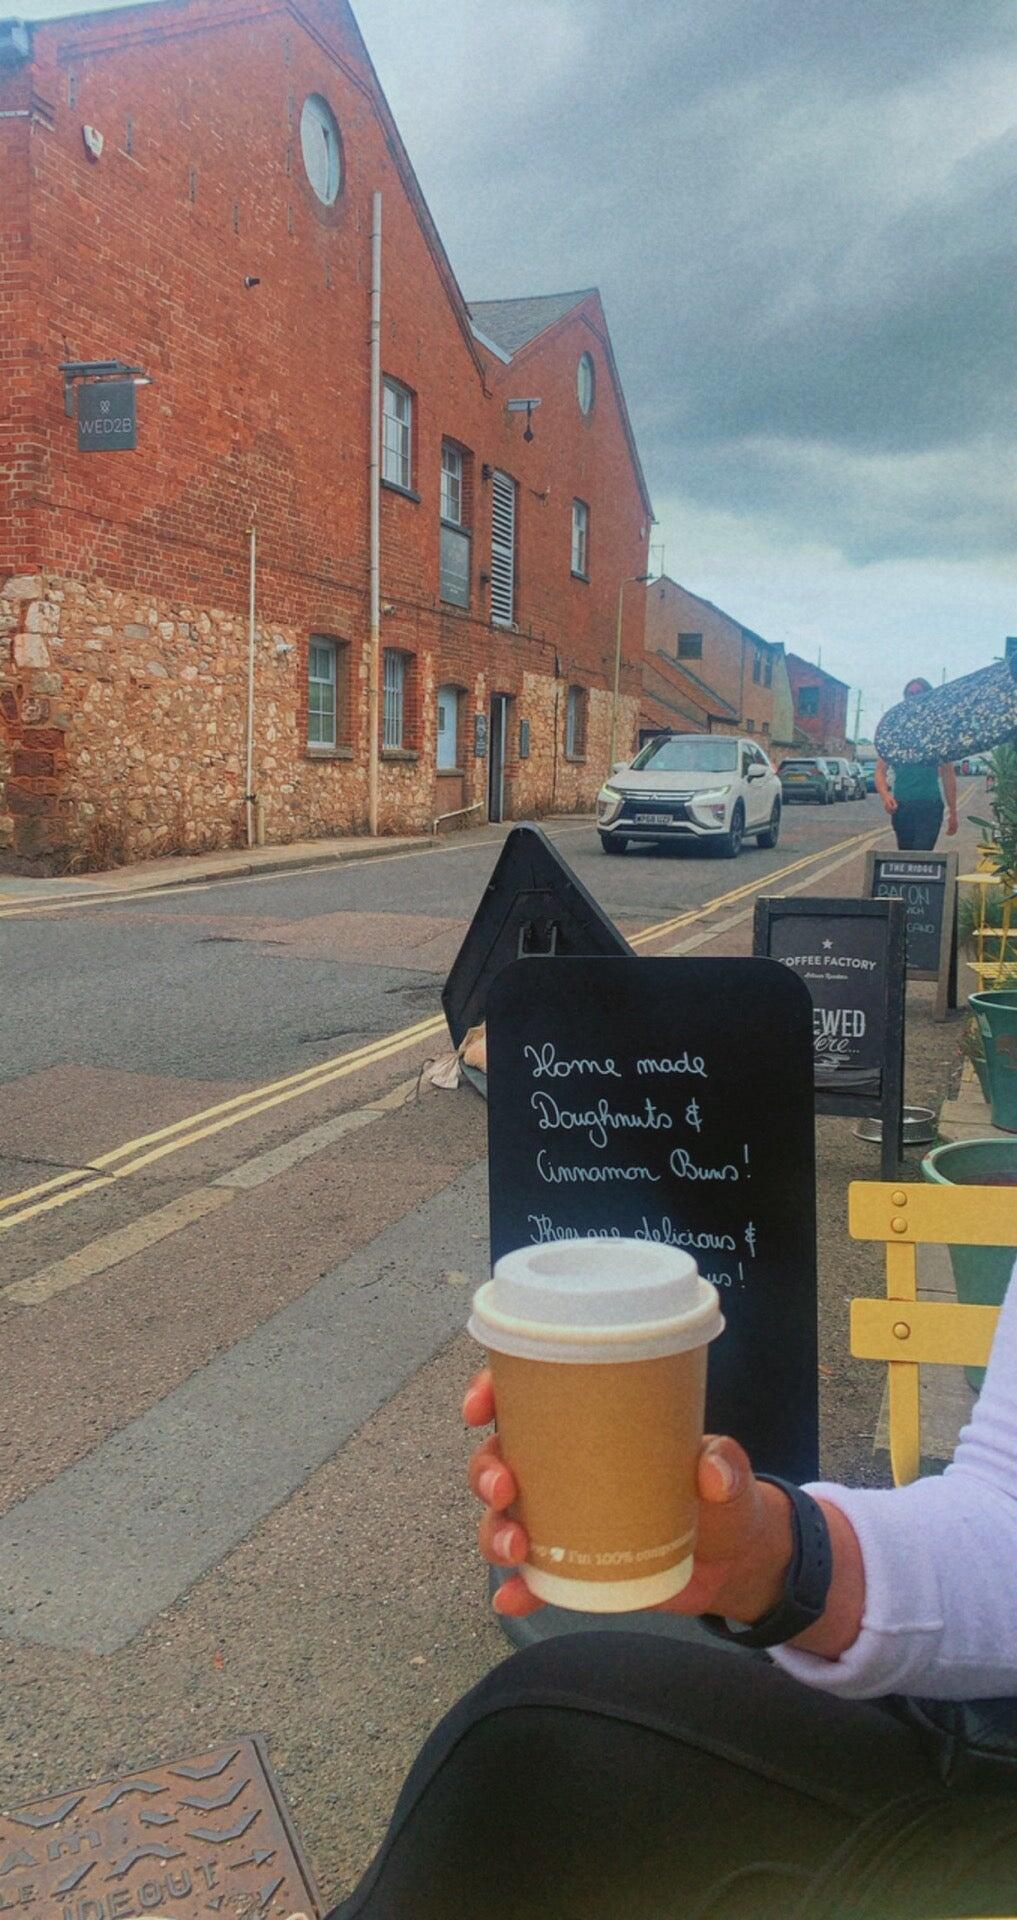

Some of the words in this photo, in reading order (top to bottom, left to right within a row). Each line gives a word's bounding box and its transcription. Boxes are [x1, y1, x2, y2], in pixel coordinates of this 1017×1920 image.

[79, 417, 132, 434] WED2B
[888, 863, 904, 873] THE
[878, 884, 930, 906] BACON
[824, 956, 877, 971] FACTORY
[813, 1007, 866, 1038] EWED
[813, 1032, 860, 1053] ere...
[523, 1042, 622, 1078] Home
[637, 1051, 708, 1078] made
[530, 1091, 673, 1148] Doughnuts
[685, 1097, 703, 1133] &
[536, 1149, 661, 1183] Cinnamon
[670, 1144, 752, 1182] Buns!
[633, 1216, 736, 1251] delicious
[596, 1551, 634, 1566] 100%
